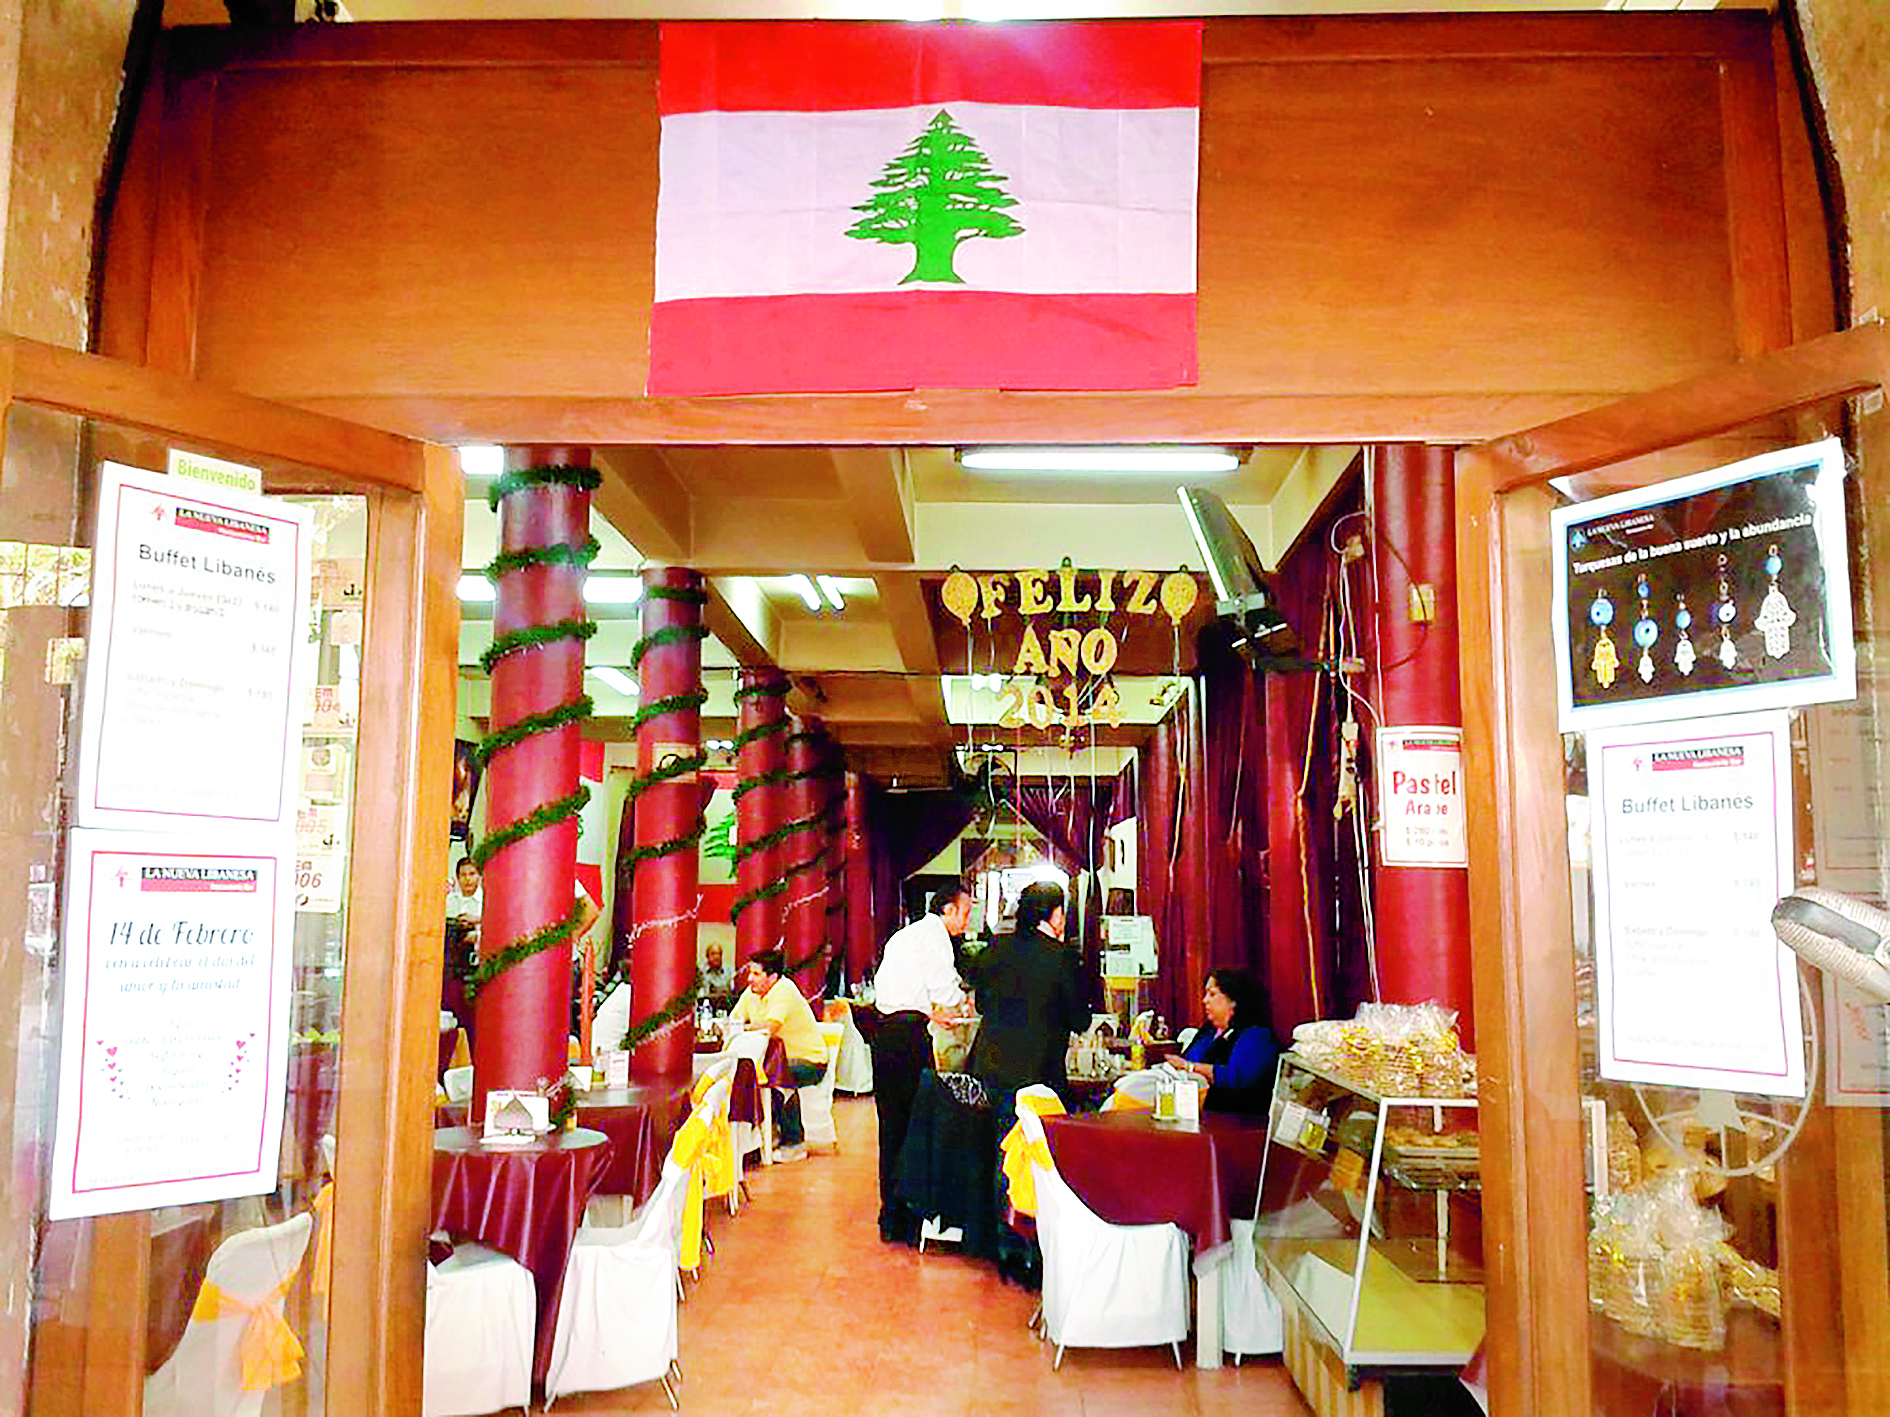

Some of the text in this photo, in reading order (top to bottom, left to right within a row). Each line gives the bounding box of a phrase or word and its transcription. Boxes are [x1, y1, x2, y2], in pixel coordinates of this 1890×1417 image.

[178, 459, 255, 490] Bienvenido
[1573, 555, 1622, 574] Turquesas
[1624, 550, 1637, 563] de
[1638, 548, 1648, 560] la
[1649, 541, 1682, 557] buena
[1719, 531, 1728, 545] y
[1728, 527, 1740, 540] la
[1741, 513, 1812, 538] abundancia
[139, 544, 275, 584] Buffet Libanés
[977, 568, 1160, 618] FELIZ
[998, 683, 1122, 730] 2014
[1392, 770, 1456, 795] Pastel
[1622, 797, 1675, 814] Buffet
[110, 921, 254, 945] 14 de Febrero
